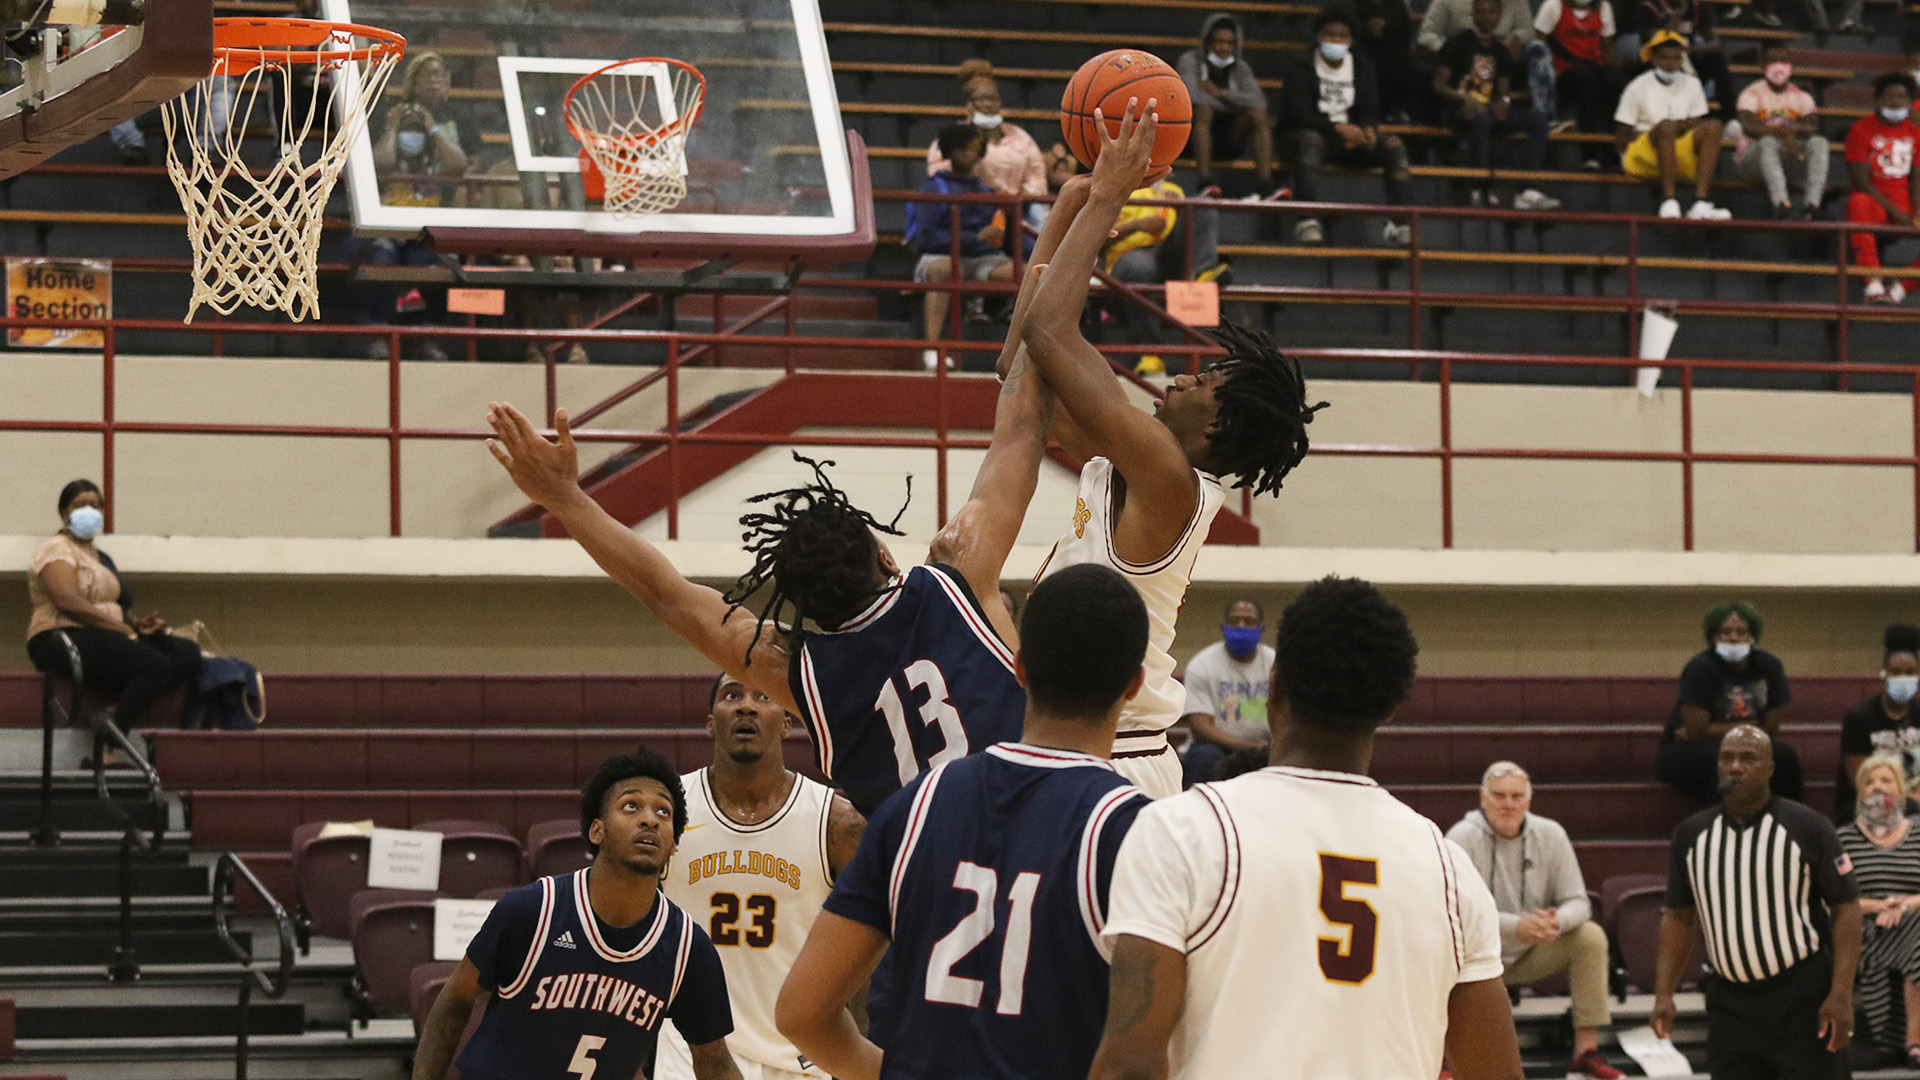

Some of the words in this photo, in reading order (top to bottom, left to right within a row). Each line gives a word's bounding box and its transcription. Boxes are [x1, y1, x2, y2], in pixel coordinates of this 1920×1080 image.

[25, 266, 96, 290] Home
[15, 295, 107, 319] Section
[874, 657, 970, 788] 13
[688, 850, 801, 890] BULLDOGS
[553, 940, 577, 950] adidas
[709, 890, 778, 950] 23
[924, 859, 1043, 1017] 21
[1316, 850, 1381, 987] 5
[530, 972, 665, 1031] SOUTHWEST
[566, 1033, 608, 1080] 5
